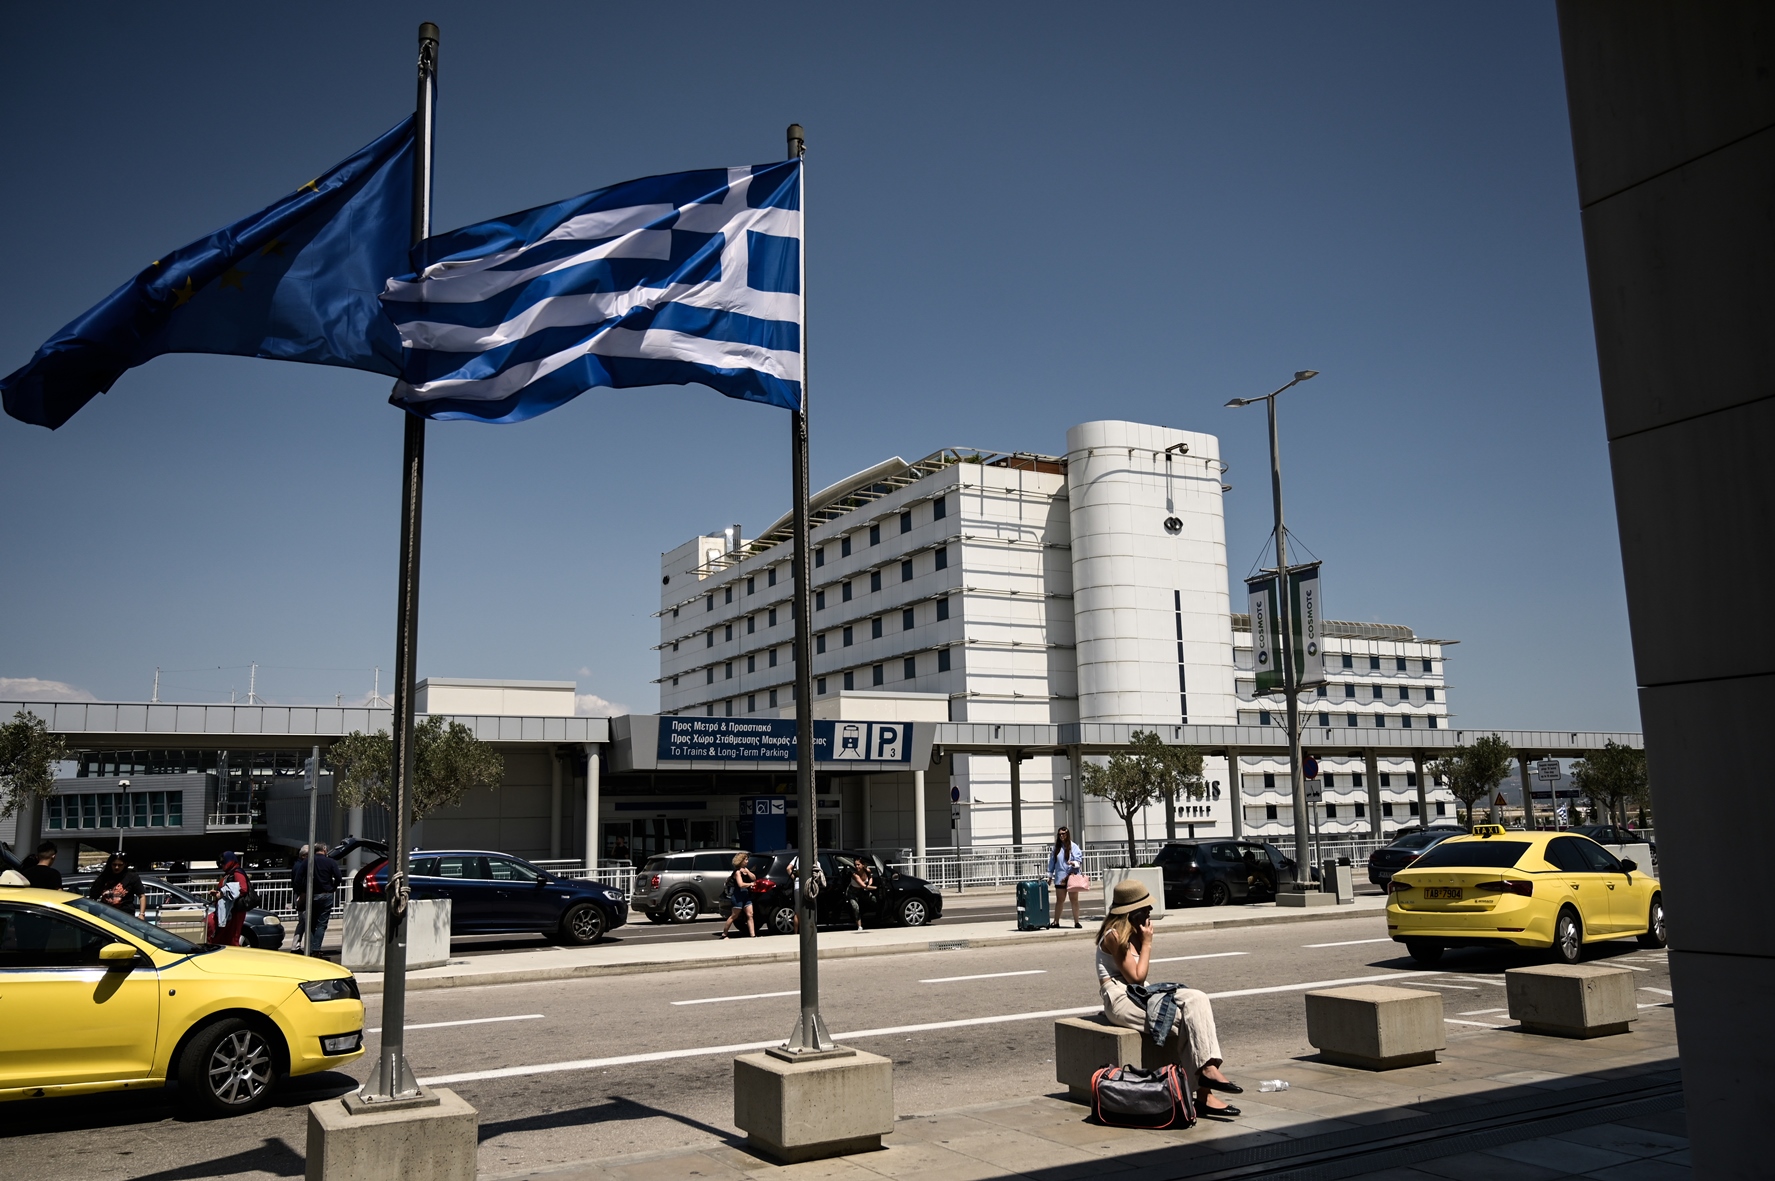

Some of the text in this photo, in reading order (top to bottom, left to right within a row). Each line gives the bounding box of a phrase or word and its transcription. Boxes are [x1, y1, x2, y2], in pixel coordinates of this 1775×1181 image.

[1256, 601, 1265, 648] COSMOTE
[1306, 589, 1314, 639] COSMOTE
[672, 721, 772, 733] Προς Μετρό & Προαστιακό
[671, 733, 691, 744] Προς
[693, 733, 714, 744] Χώρο
[716, 734, 760, 745] Στάθμευσης
[761, 735, 790, 746] Μακράς
[878, 727, 897, 758] P 3
[670, 746, 789, 758] To Trains & Long-Term Parking
